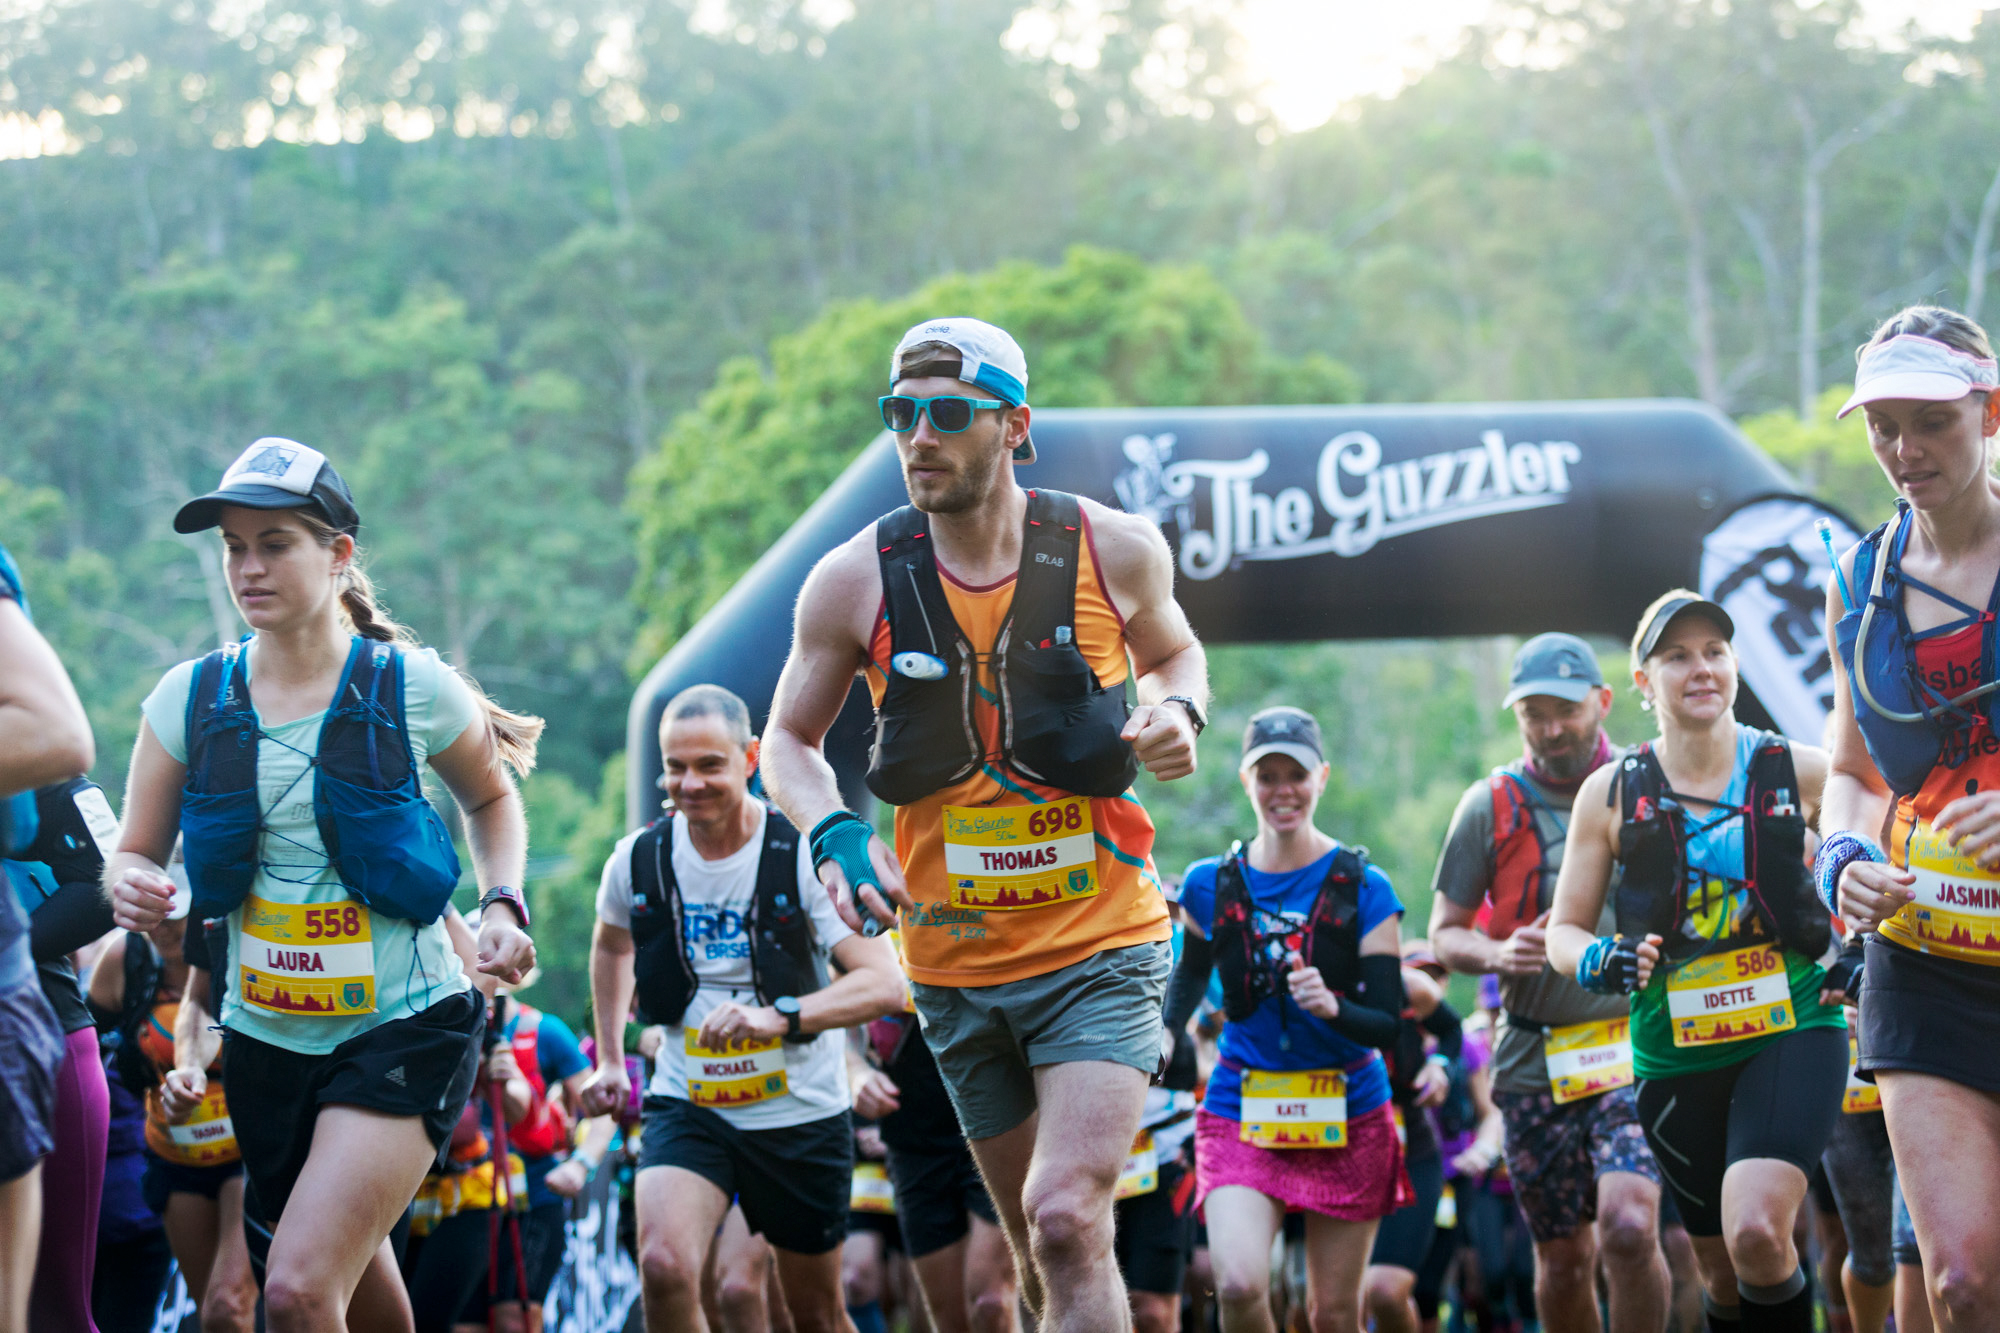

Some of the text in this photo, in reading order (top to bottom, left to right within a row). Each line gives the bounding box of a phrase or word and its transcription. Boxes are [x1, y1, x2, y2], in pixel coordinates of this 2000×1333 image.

[1161, 428, 1582, 581] The Guzzler
[1028, 803, 1082, 837] 698
[979, 846, 1058, 871] THOMAS
[305, 906, 361, 939] 558
[267, 948, 325, 972] LAURA
[1736, 948, 1776, 977] 586
[1703, 986, 1756, 1009] IDETTE
[703, 1059, 759, 1076] MICHAEL
[1276, 1103, 1307, 1118] KATE
